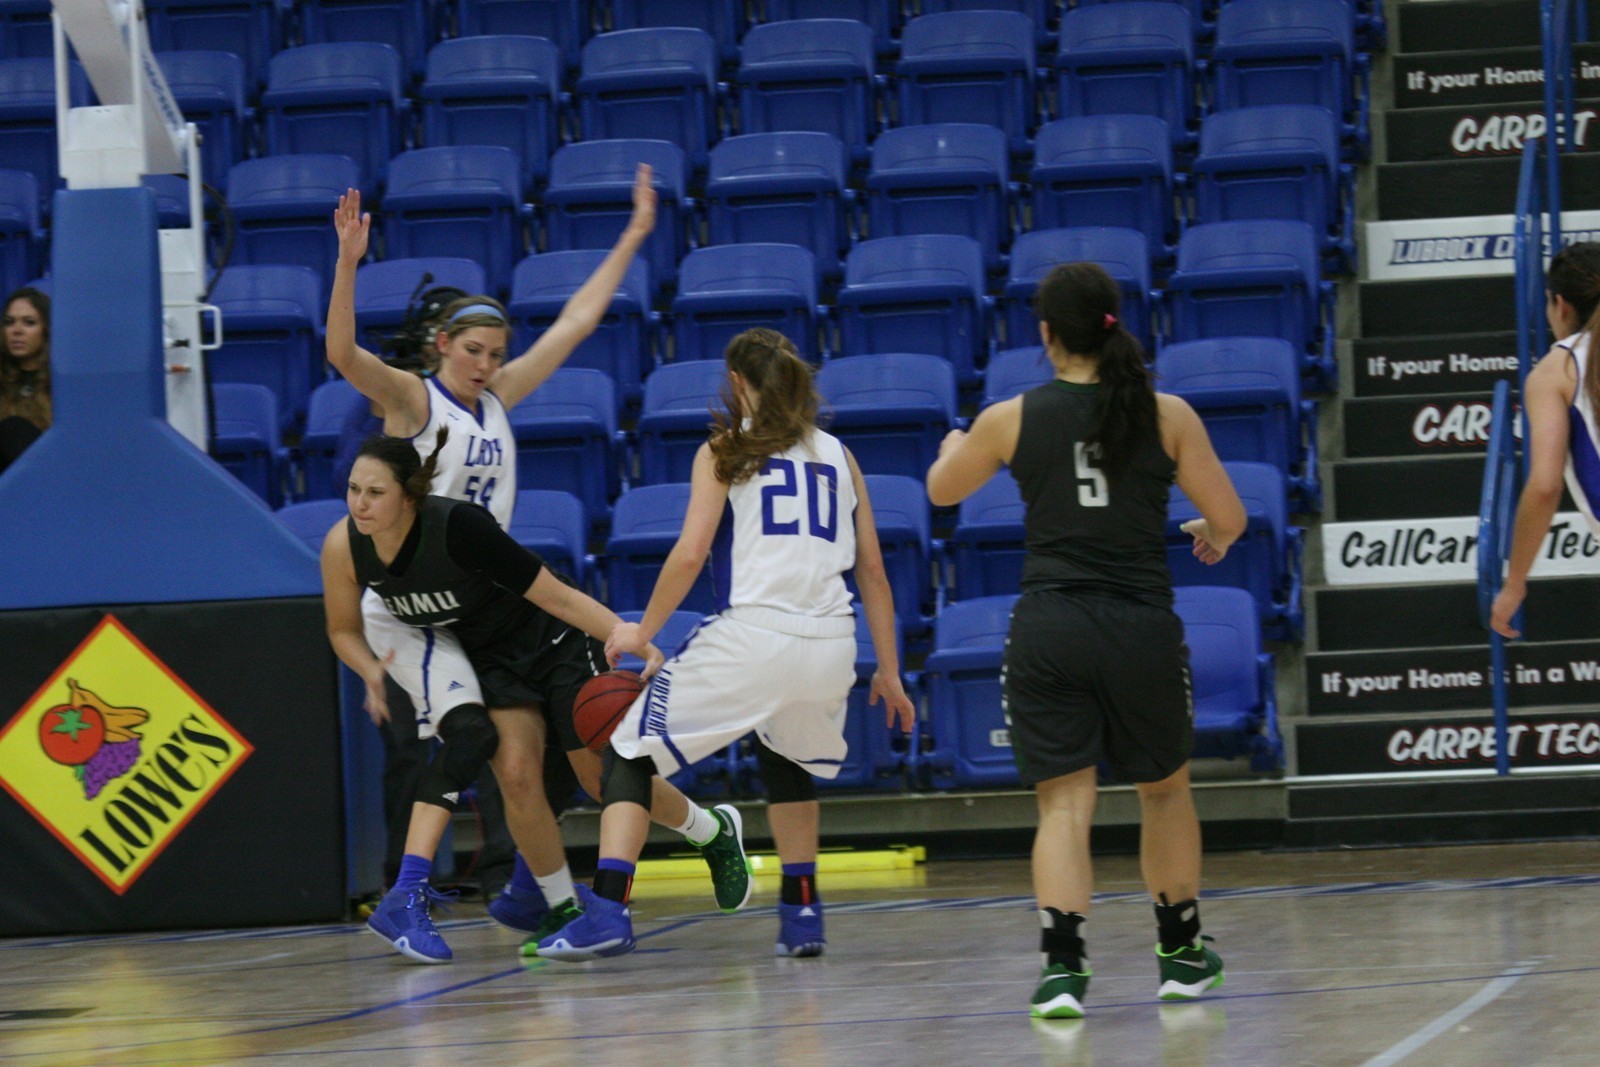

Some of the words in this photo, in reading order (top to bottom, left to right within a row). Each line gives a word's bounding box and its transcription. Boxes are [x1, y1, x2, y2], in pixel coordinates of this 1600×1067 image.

[1407, 72, 1425, 90] If
[1428, 74, 1480, 93] your
[1392, 236, 1490, 264] LUBBOCK
[1367, 357, 1387, 376] If
[1390, 359, 1443, 380] your
[1449, 353, 1520, 373] Home
[1412, 403, 1523, 443] CAR
[464, 435, 503, 467] LADY
[1074, 441, 1109, 507] 5
[759, 457, 838, 543] 20
[1322, 671, 1342, 693] If
[1346, 674, 1403, 697] your
[1408, 668, 1483, 689] Home
[1515, 663, 1541, 684] in
[1546, 667, 1565, 683] a
[1568, 660, 1600, 682] W
[1387, 724, 1530, 763] CARPET
